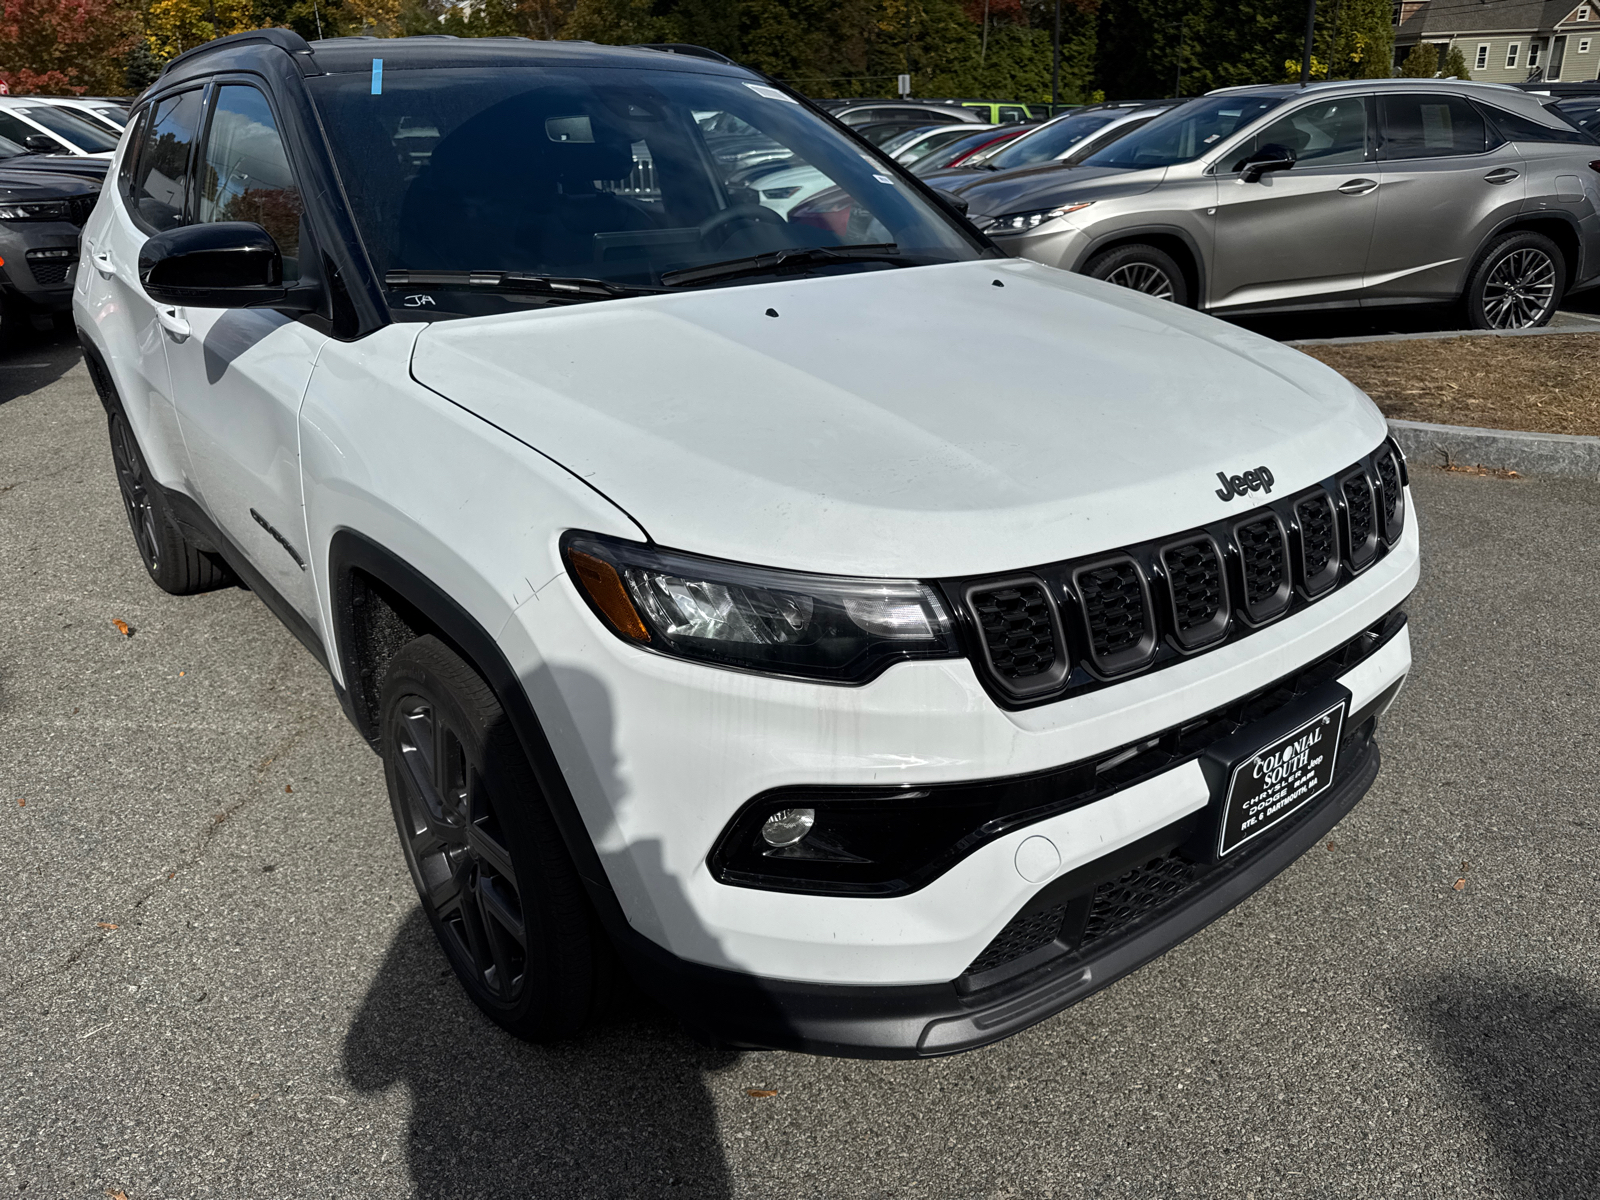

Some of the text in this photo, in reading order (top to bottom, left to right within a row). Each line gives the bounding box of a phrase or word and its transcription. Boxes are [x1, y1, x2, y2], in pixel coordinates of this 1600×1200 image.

[1215, 465, 1275, 502] Jeep
[1253, 727, 1322, 779] COLONIAL
[1263, 749, 1310, 789] SOUTH
[1242, 754, 1324, 809] CHRYSLER Jeep
[1249, 769, 1315, 816] DODGE RAM
[1258, 812, 1264, 821] 6
[1308, 777, 1318, 789] MA
